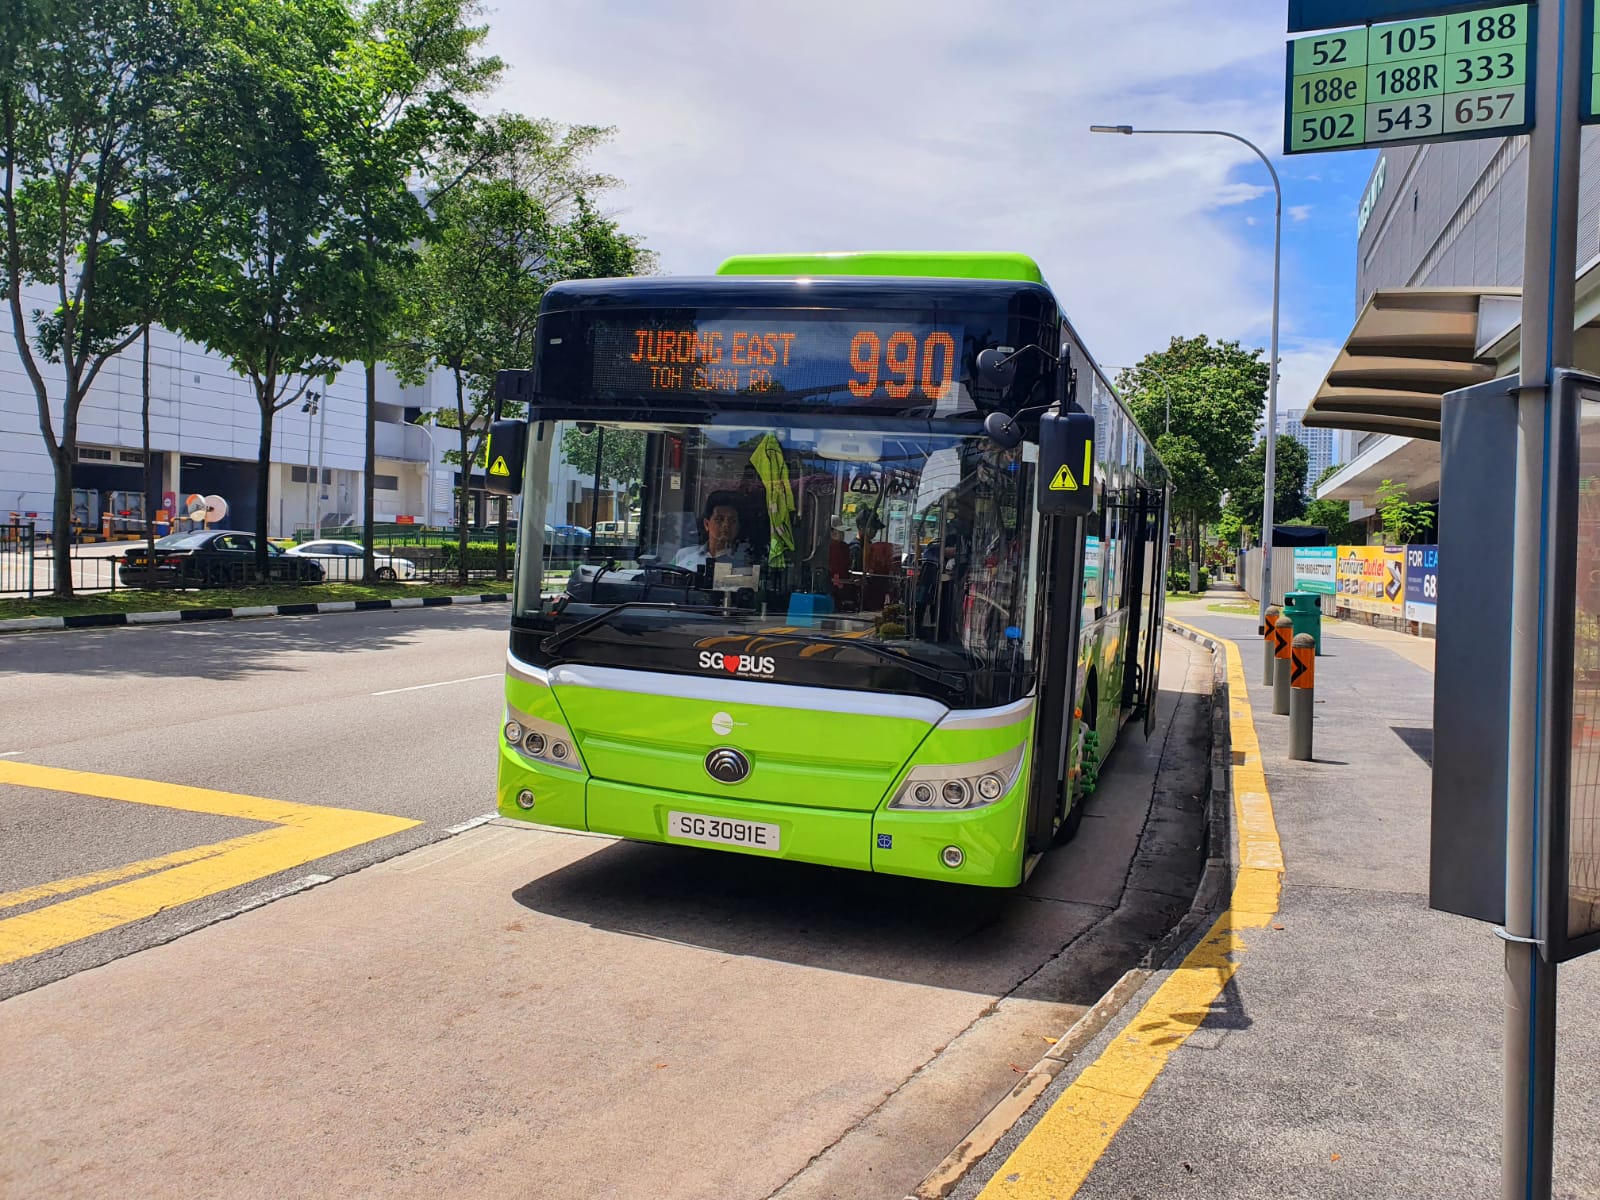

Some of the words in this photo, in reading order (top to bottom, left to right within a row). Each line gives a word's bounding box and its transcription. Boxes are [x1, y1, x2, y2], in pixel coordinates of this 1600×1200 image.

[1312, 38, 1347, 66] 52
[1380, 24, 1436, 56] 105
[1458, 13, 1516, 45] 188
[1300, 77, 1357, 105] 188e
[1376, 64, 1439, 96] 188R
[1455, 52, 1515, 85] 333
[1302, 113, 1355, 143] 502
[1377, 103, 1433, 134] 543
[1455, 93, 1516, 124] 657
[630, 329, 724, 364] JURONG
[731, 331, 797, 366] EAST
[848, 331, 954, 400] 990
[650, 366, 682, 389] TOH
[692, 367, 738, 391] GUAN
[748, 369, 772, 392] RD
[1408, 550, 1423, 567] FOR
